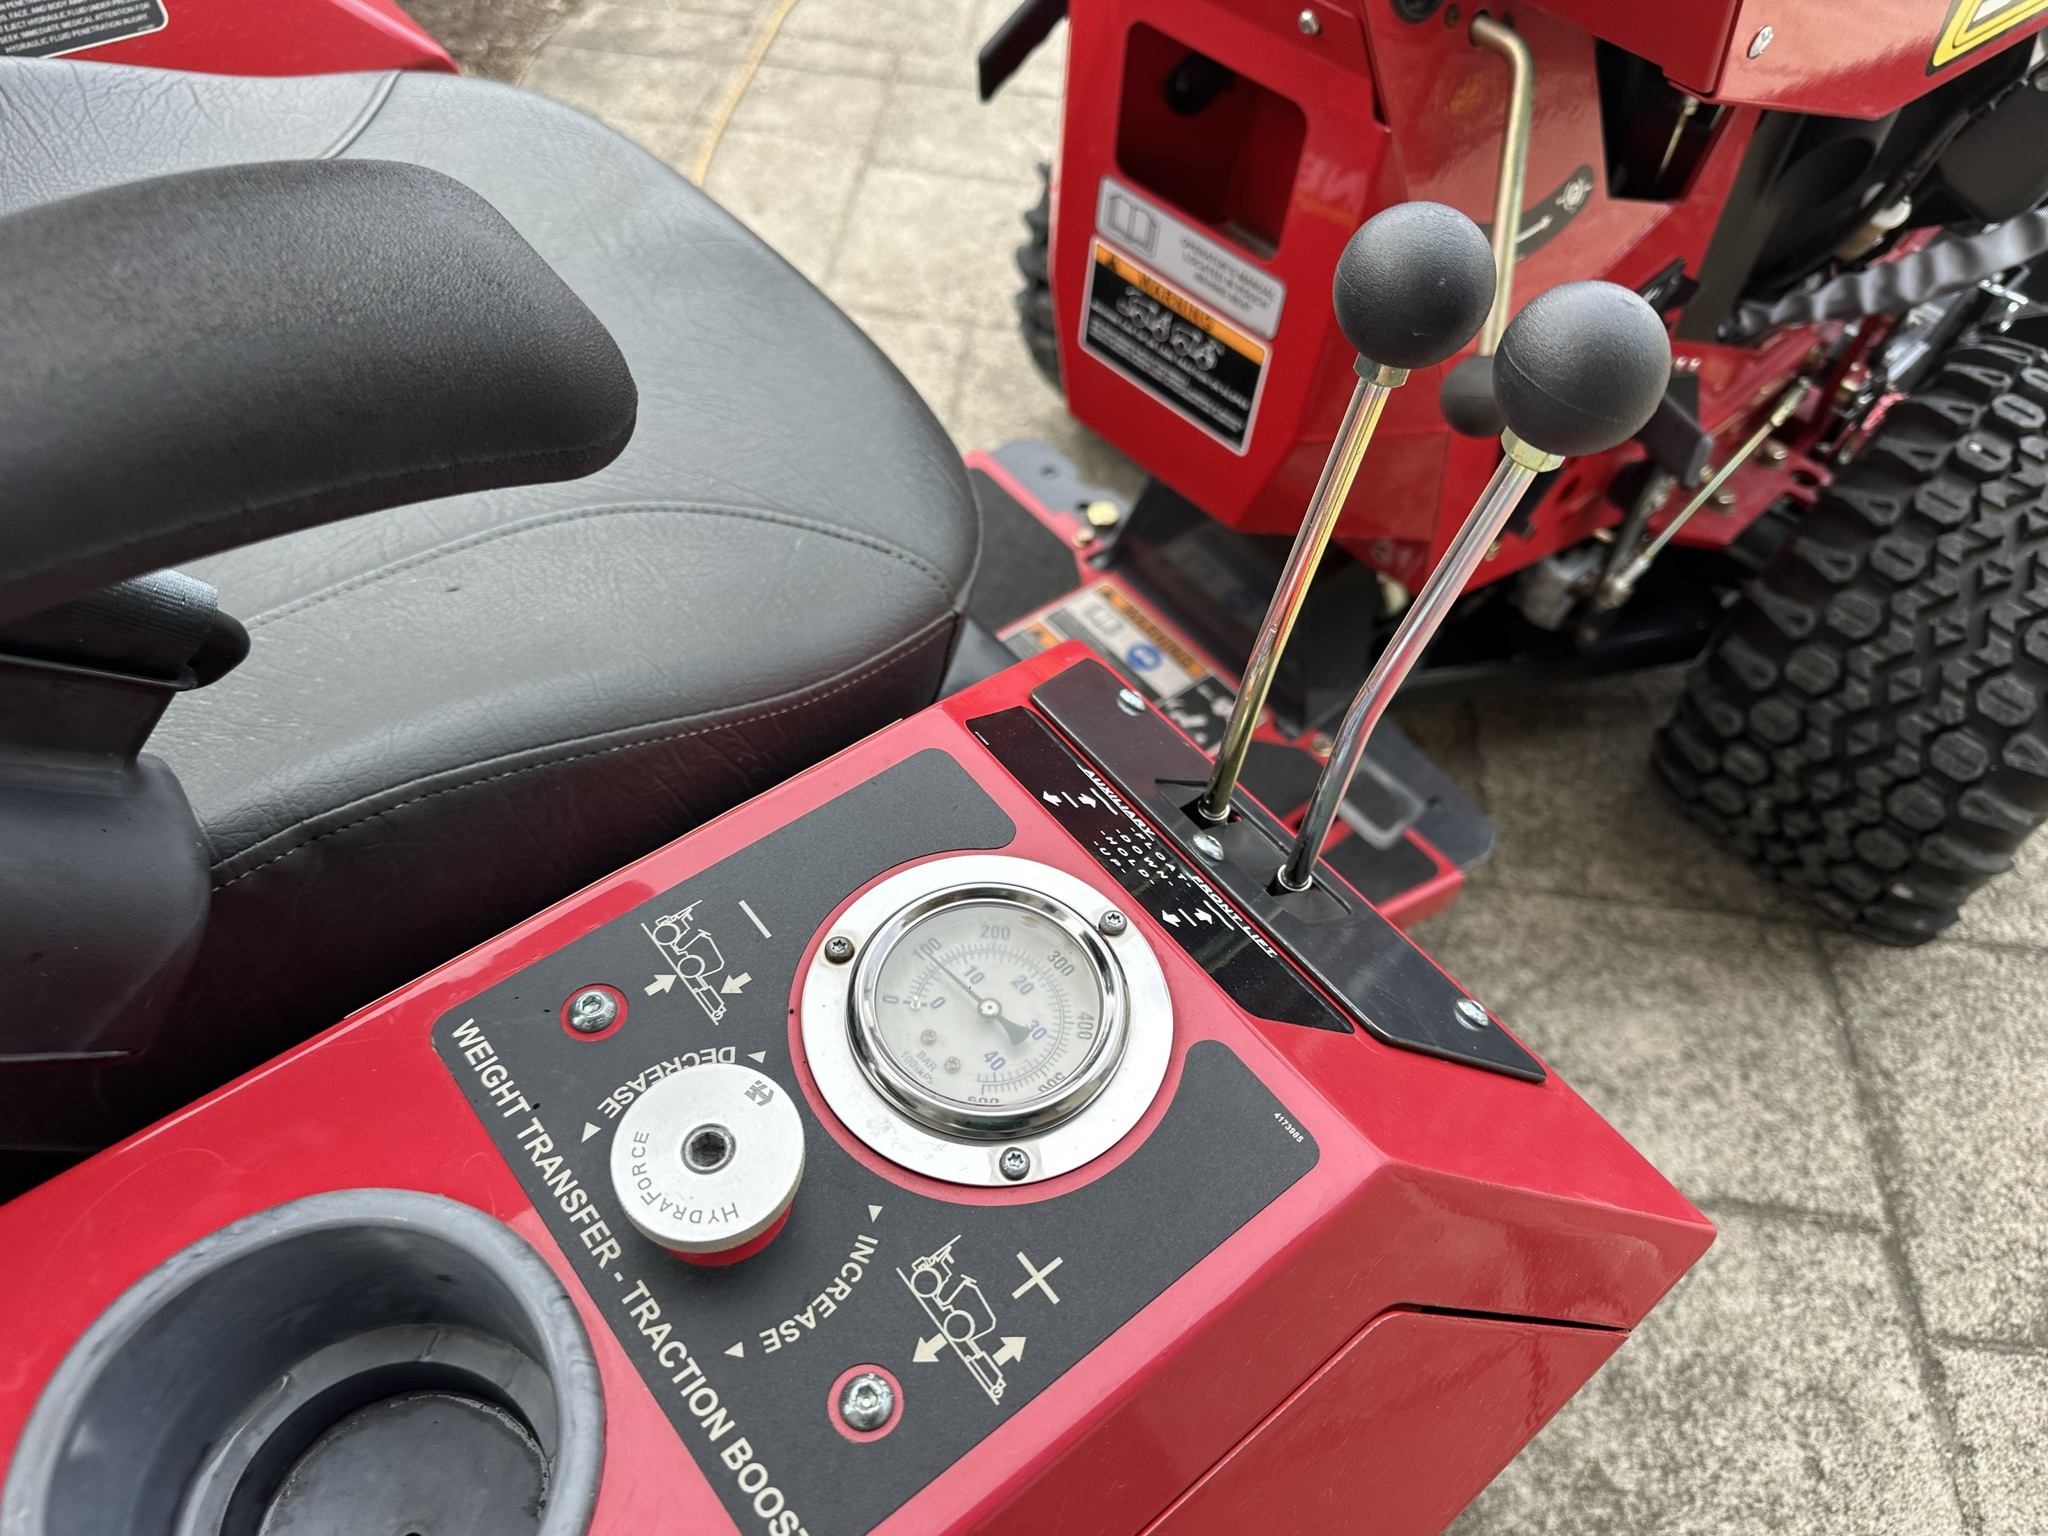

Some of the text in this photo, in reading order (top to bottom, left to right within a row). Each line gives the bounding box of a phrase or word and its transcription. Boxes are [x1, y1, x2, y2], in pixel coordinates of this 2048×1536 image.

[1079, 766, 1156, 840] AUXILIARY
[1190, 875, 1278, 957] FRONT LIFT
[981, 925, 1011, 940] 200
[912, 937, 942, 961] 100
[1047, 949, 1075, 977] 300
[964, 965, 986, 986] 10
[1010, 974, 1035, 996] 20
[930, 996, 946, 1010] 0
[1076, 1011, 1094, 1041] 400
[916, 1050, 938, 1073] BAR
[983, 1050, 1007, 1072] 40
[597, 1046, 736, 1119] DECREASE
[631, 1130, 739, 1225] HYDRAFORCE
[451, 1017, 532, 1118] WEIGHT
[516, 1116, 622, 1270] TRANSFER
[621, 1279, 736, 1442] TRACTION
[719, 1436, 810, 1536] BOOS
[759, 1234, 879, 1354] INCREASE
